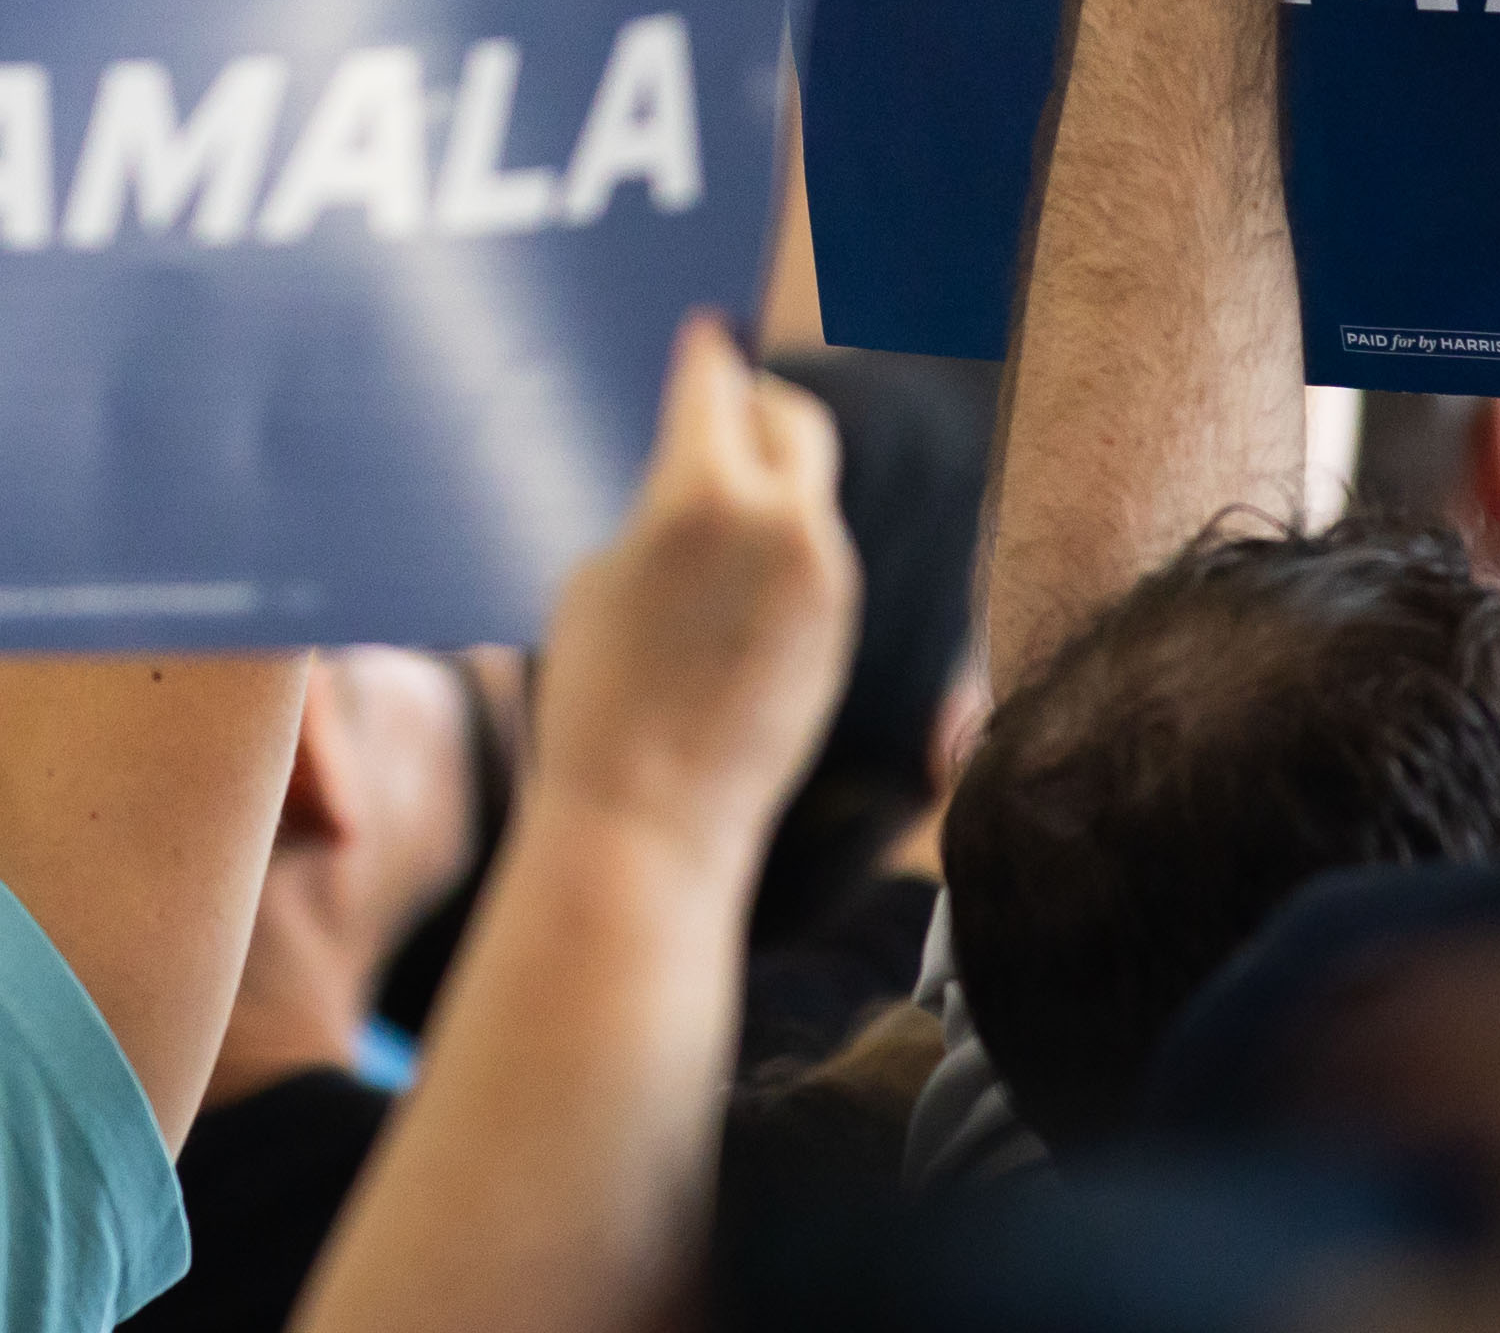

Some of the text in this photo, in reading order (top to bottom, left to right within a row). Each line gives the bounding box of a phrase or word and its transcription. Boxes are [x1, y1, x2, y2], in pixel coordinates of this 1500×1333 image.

[1347, 333, 1388, 347] PAID
[1390, 334, 1416, 351] for
[1419, 335, 1437, 353] by
